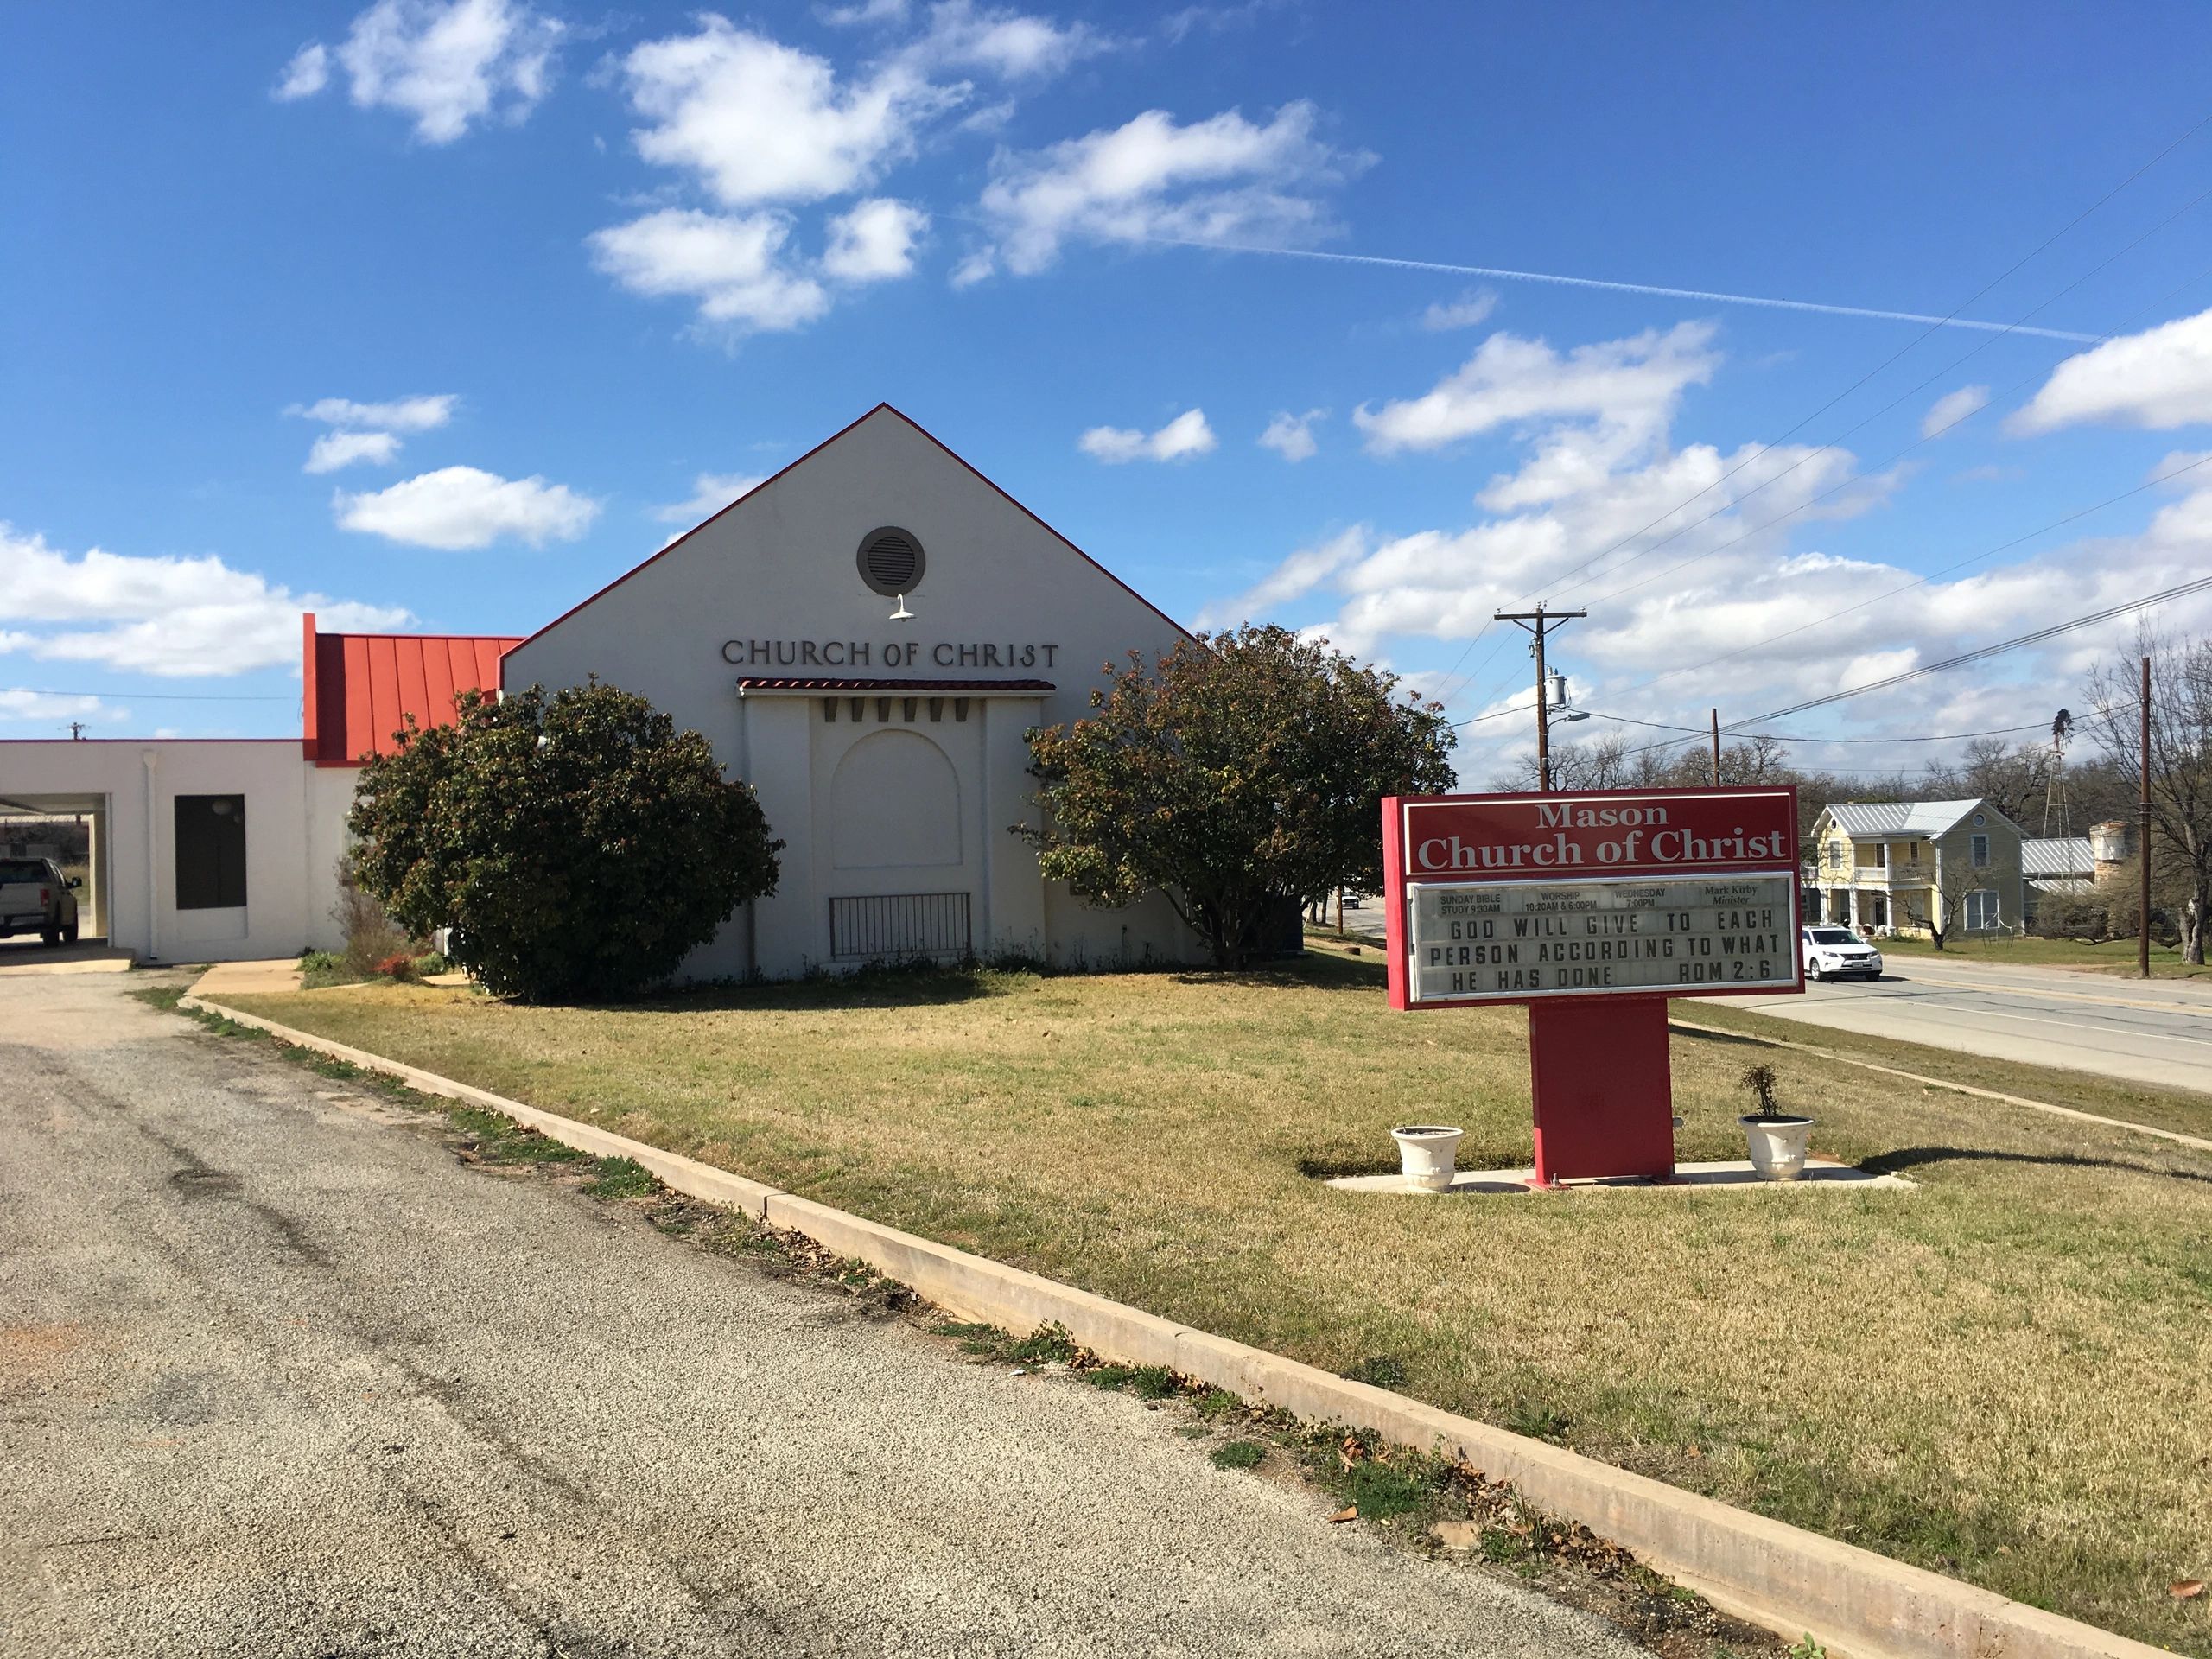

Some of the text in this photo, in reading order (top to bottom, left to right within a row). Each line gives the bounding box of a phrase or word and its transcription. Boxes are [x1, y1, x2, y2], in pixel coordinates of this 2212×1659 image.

[721, 639, 1059, 668] CHURCH OF CHRIST
[1535, 804, 1669, 830] Mason
[1418, 827, 1786, 869] Church of Christ
[1615, 888, 1666, 898] WEDNESDAY
[1705, 885, 1758, 896] Mark Kirby
[1440, 893, 1501, 905] SUNDAY BIBLE
[1541, 892, 1580, 901] WORSHIP
[1713, 896, 1750, 906] Minister
[1560, 902, 1567, 911] &
[1568, 900, 1598, 911] 6:00PM
[1626, 899, 1655, 907] 7:00PM
[1441, 904, 1501, 914] STUDY 9:30AM
[1451, 909, 1774, 940] GOD WILL GIVE TO EACH
[1431, 933, 1778, 967] PERSON ACCORDING TO WHAT
[1452, 959, 1770, 991] HE HAS DONE ROM 2:6
